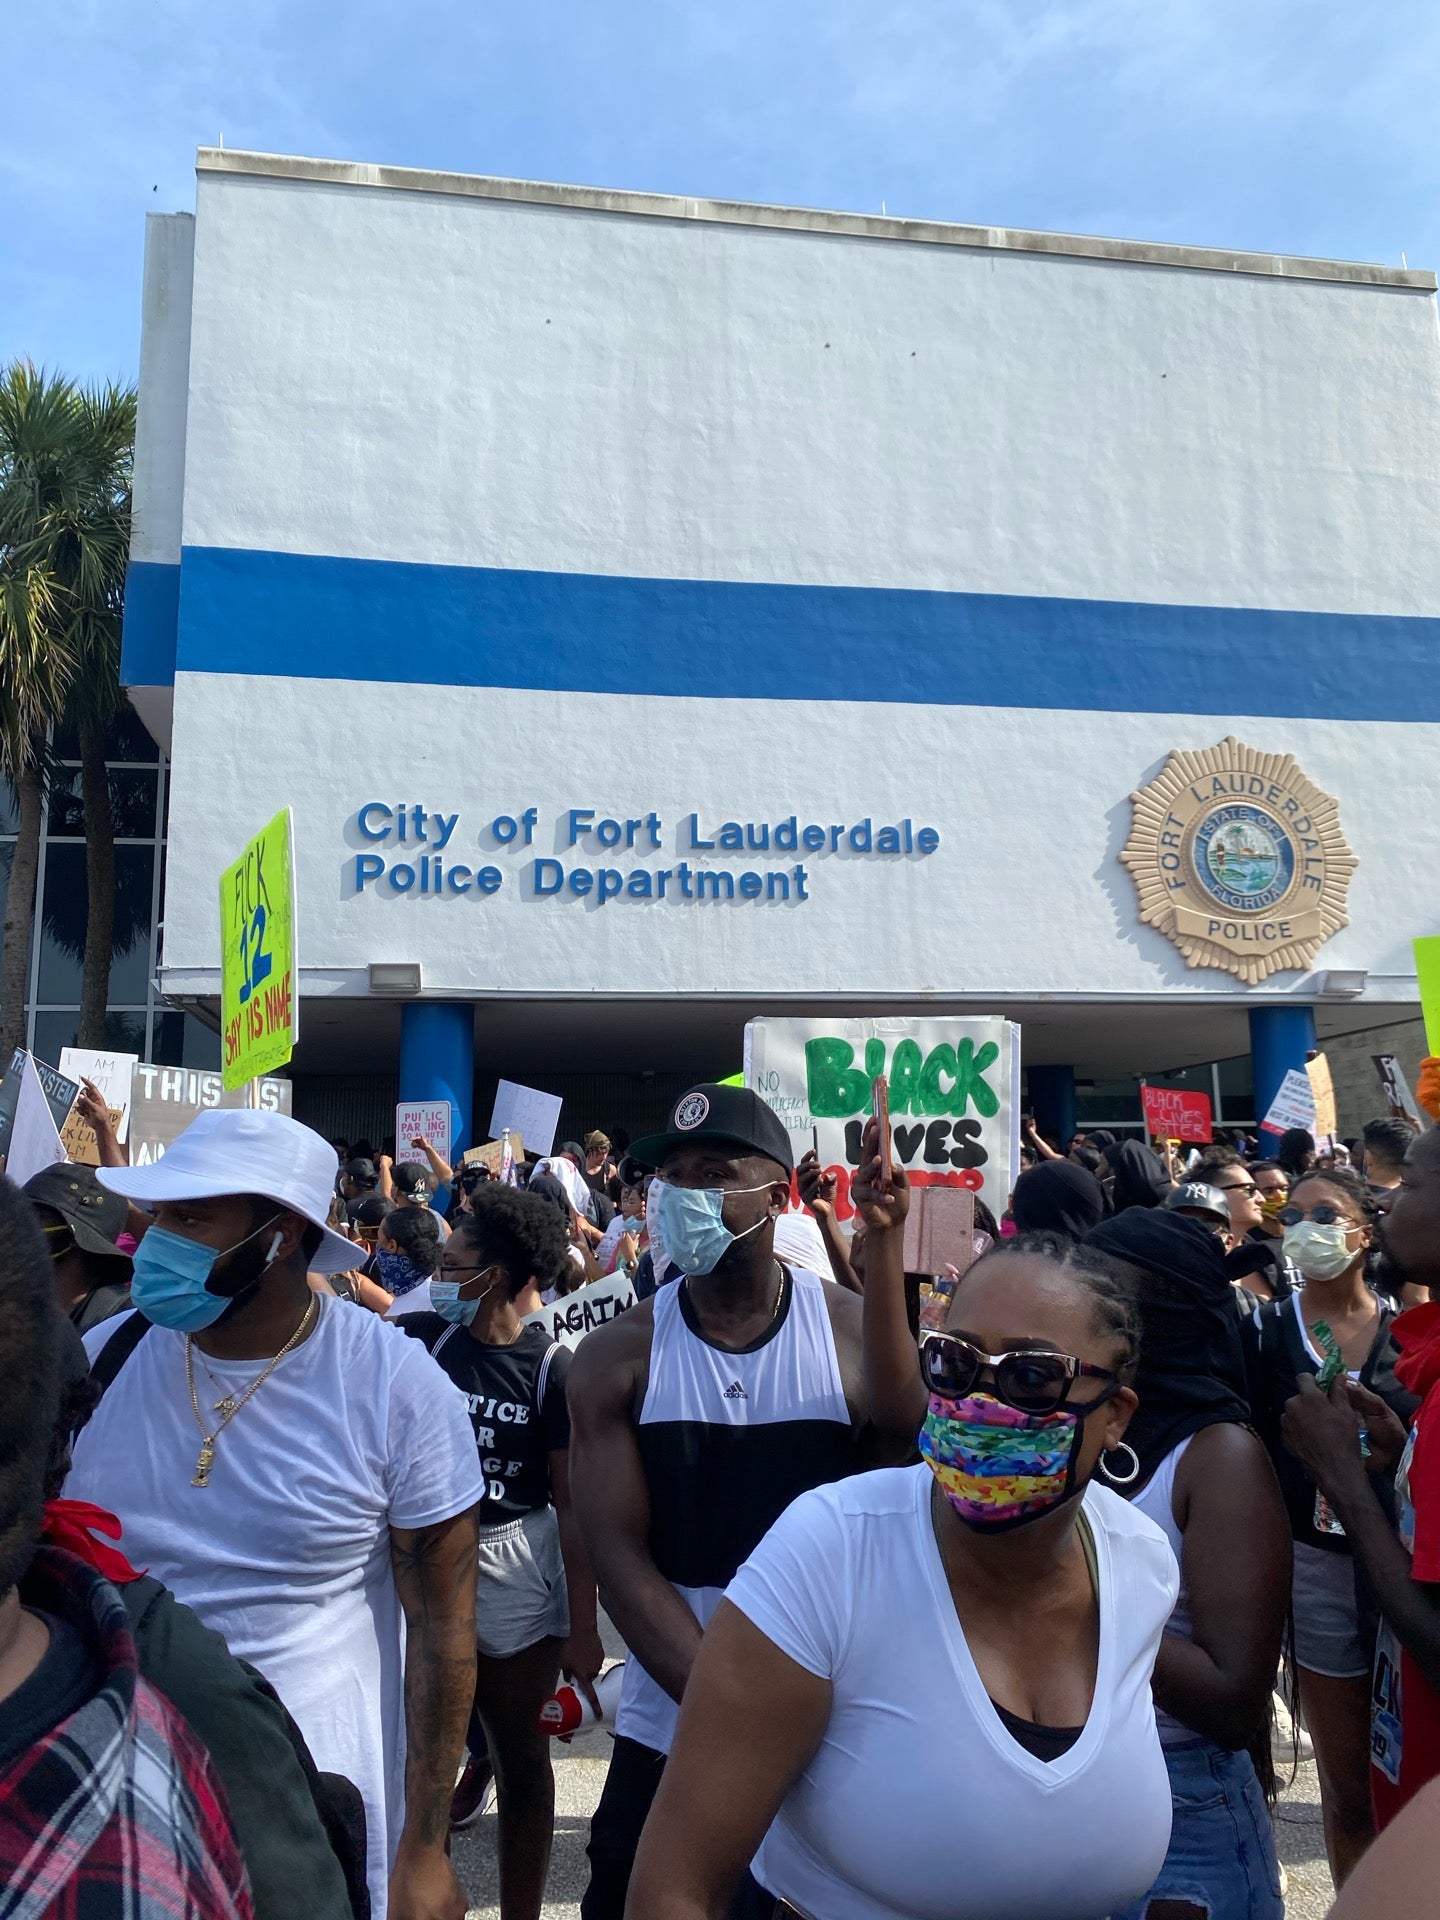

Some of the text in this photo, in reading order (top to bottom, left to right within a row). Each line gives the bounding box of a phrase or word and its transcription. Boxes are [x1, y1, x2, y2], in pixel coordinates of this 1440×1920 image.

[358, 802, 940, 854] City of Fort Lauderdale
[1160, 774, 1323, 893] FORT LAUDERDALE
[1204, 808, 1280, 836] STATE OF
[356, 854, 809, 904] Police Department
[1210, 885, 1281, 909] FLORIDA
[1208, 920, 1292, 941] POLICE
[239, 904, 272, 1005] 12
[225, 1012, 241, 1066] SAY
[265, 970, 291, 1035] NAME
[94, 1058, 115, 1071] AM
[758, 1070, 780, 1092] NO
[804, 1037, 1001, 1118] BLACK
[37, 1066, 76, 1106] SYSTEM
[139, 1067, 222, 1107] THIS
[1144, 1088, 1184, 1112] BLACK
[401, 1121, 445, 1132] PARING
[1160, 1109, 1204, 1125] LIVES
[402, 1132, 412, 1140] 30
[844, 1119, 988, 1168] LVES
[553, 1292, 633, 1342] AGAIN
[723, 1391, 749, 1400] adidas
